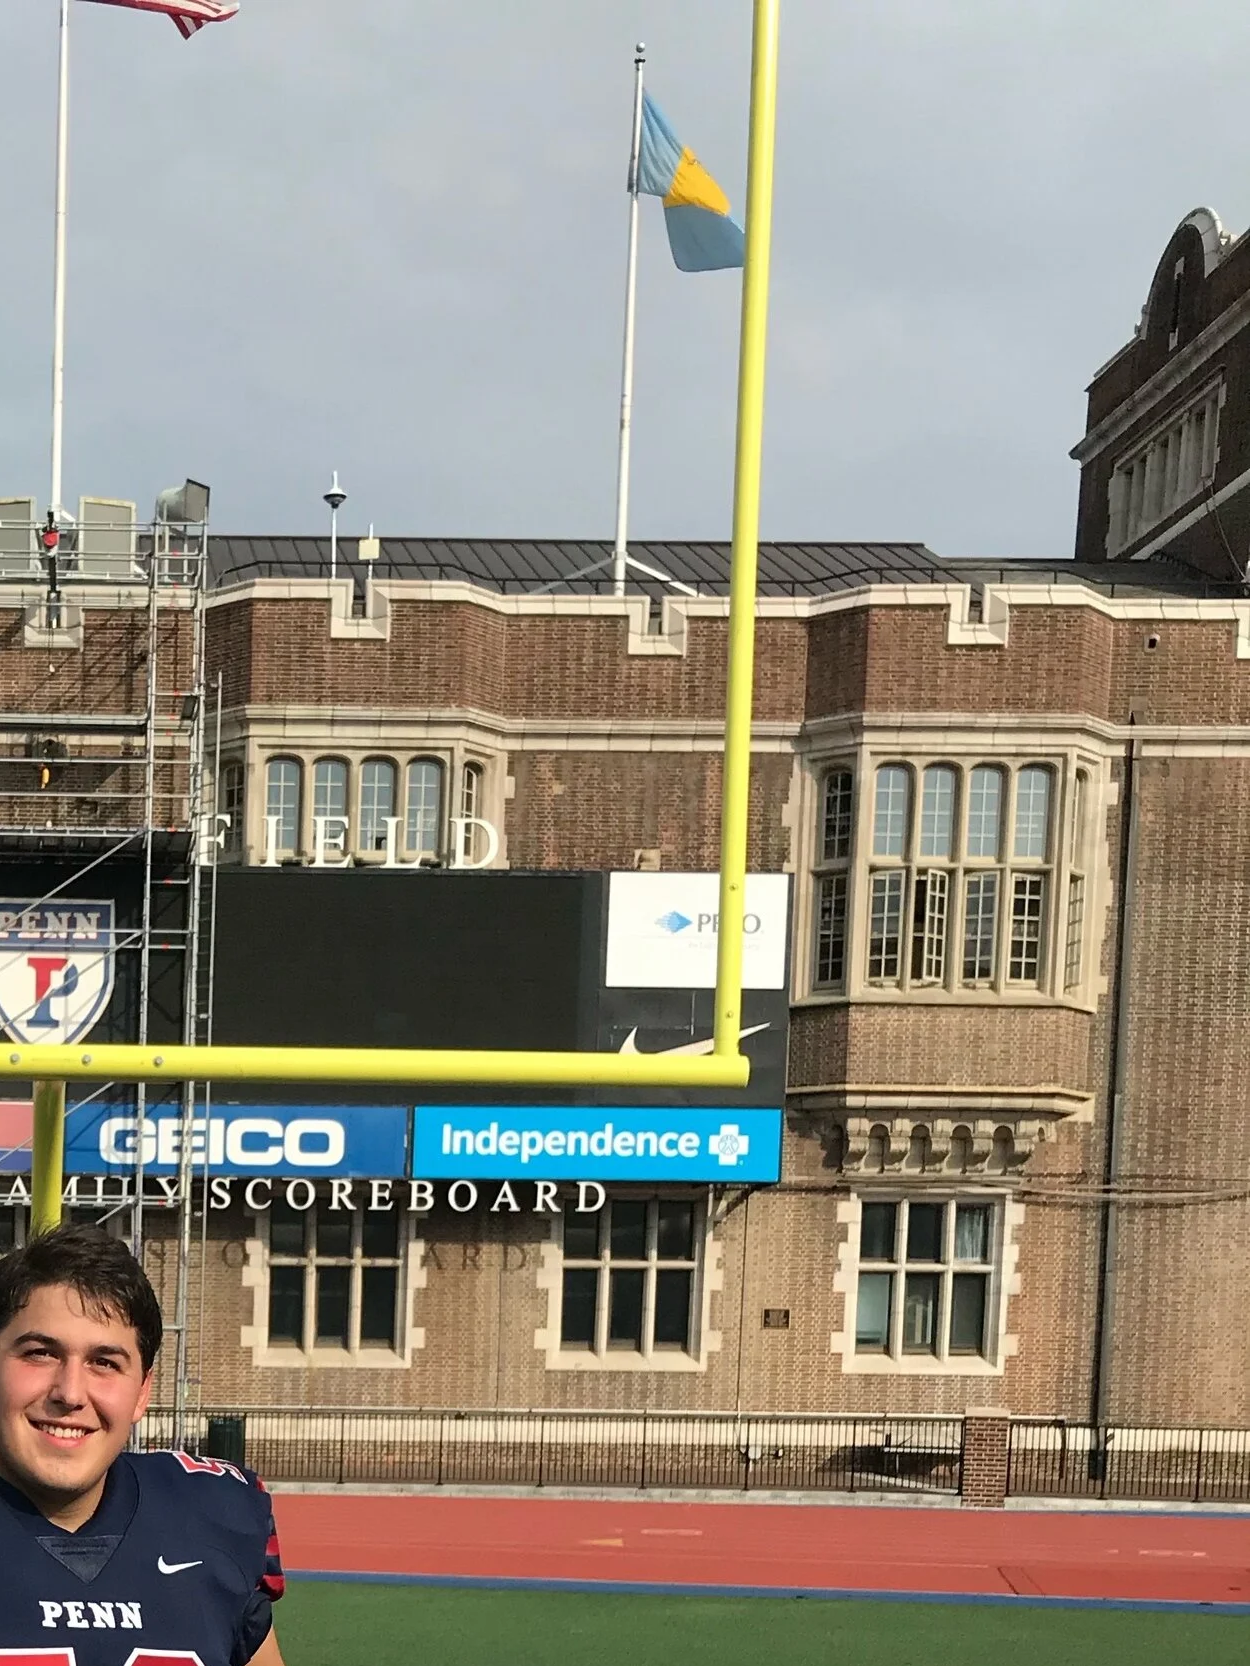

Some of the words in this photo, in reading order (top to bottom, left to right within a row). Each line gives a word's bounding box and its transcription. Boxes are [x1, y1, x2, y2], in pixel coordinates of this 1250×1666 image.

[197, 814, 499, 869] FIELD
[697, 912, 762, 934] PEO
[99, 1117, 345, 1167] GEICO
[441, 1123, 700, 1163] Independence
[210, 1176, 608, 1213] SCOREBOARD
[38, 1600, 143, 1629] PENN
